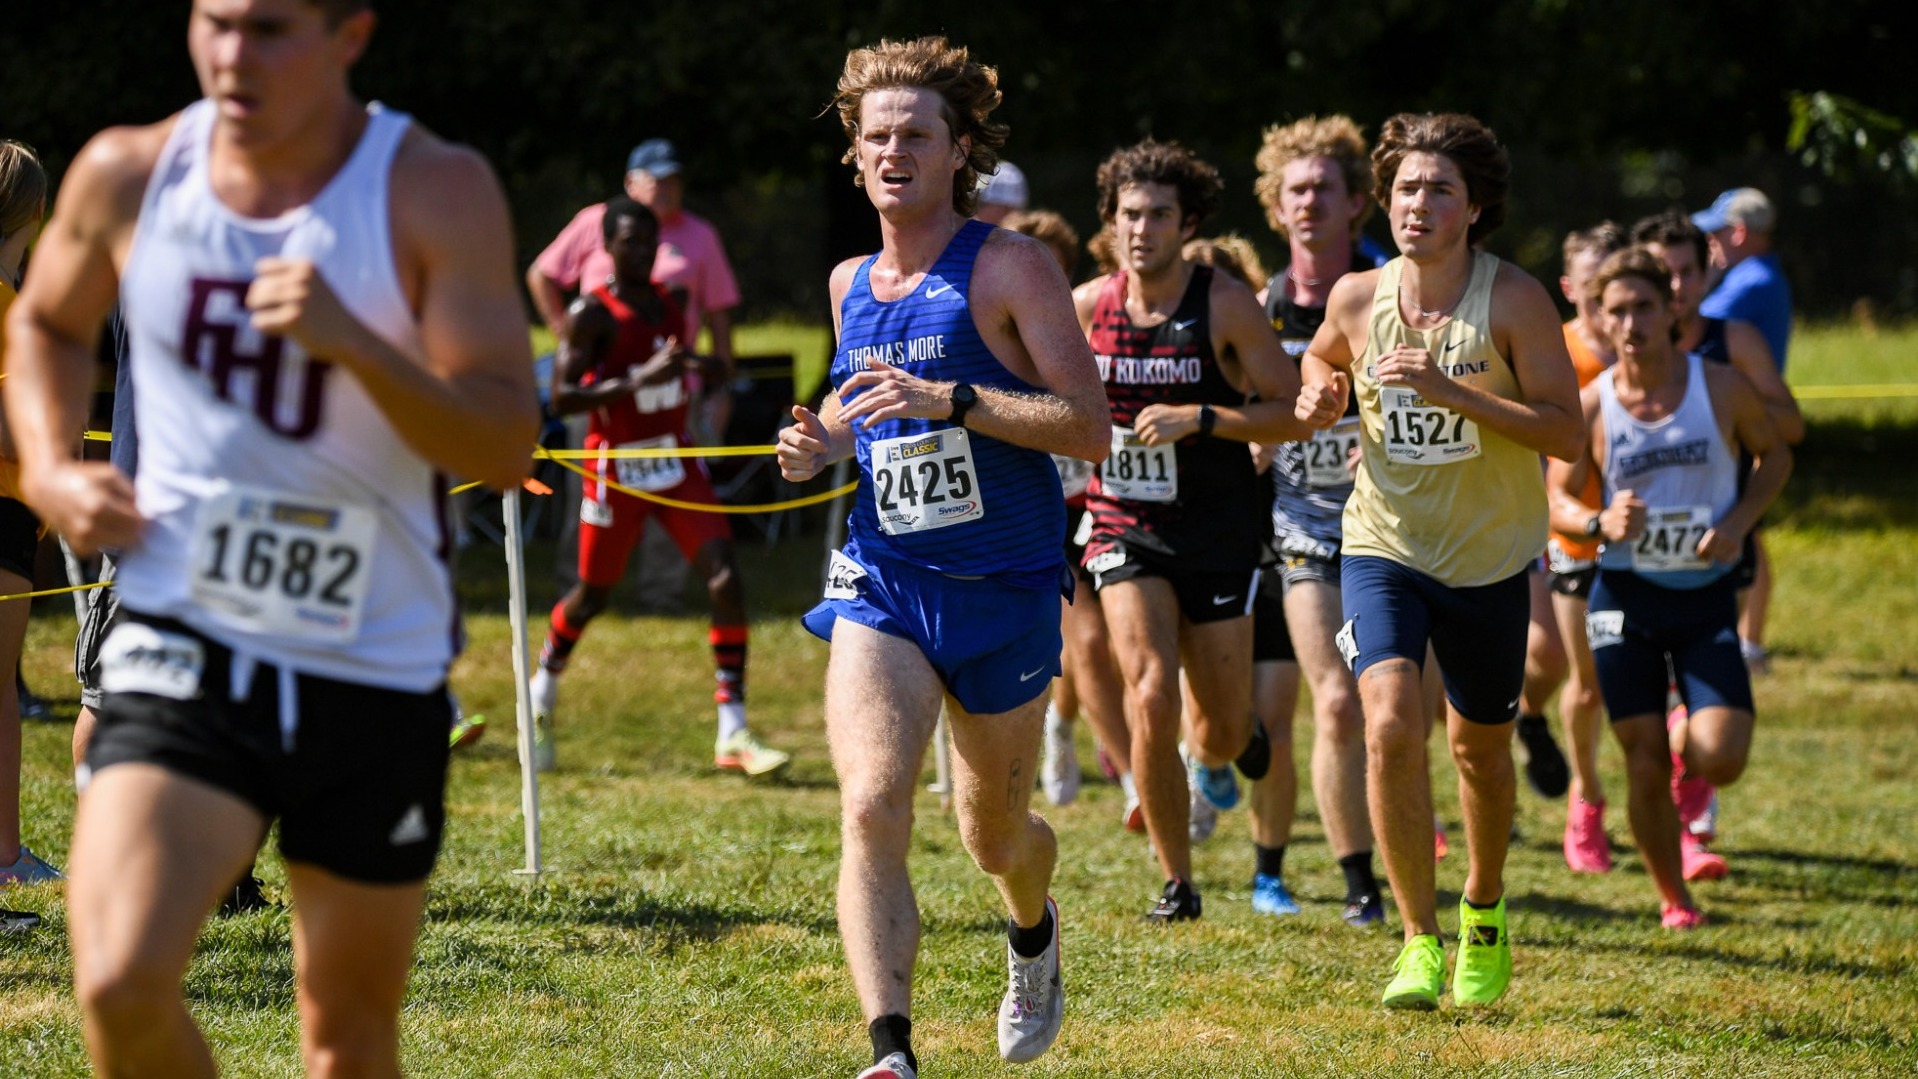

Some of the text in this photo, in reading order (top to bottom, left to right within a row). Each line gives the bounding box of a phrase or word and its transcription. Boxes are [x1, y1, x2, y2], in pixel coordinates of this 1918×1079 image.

[848, 335, 946, 372] THOMAS MORE
[1116, 357, 1201, 384] KOKOMO
[1388, 410, 1466, 446] 1527
[903, 441, 938, 458] CLASSIC
[1106, 450, 1169, 482] 1811
[876, 455, 972, 511] 2425
[882, 513, 911, 523] saucony
[938, 502, 971, 516] Swags
[202, 522, 361, 607] 1682
